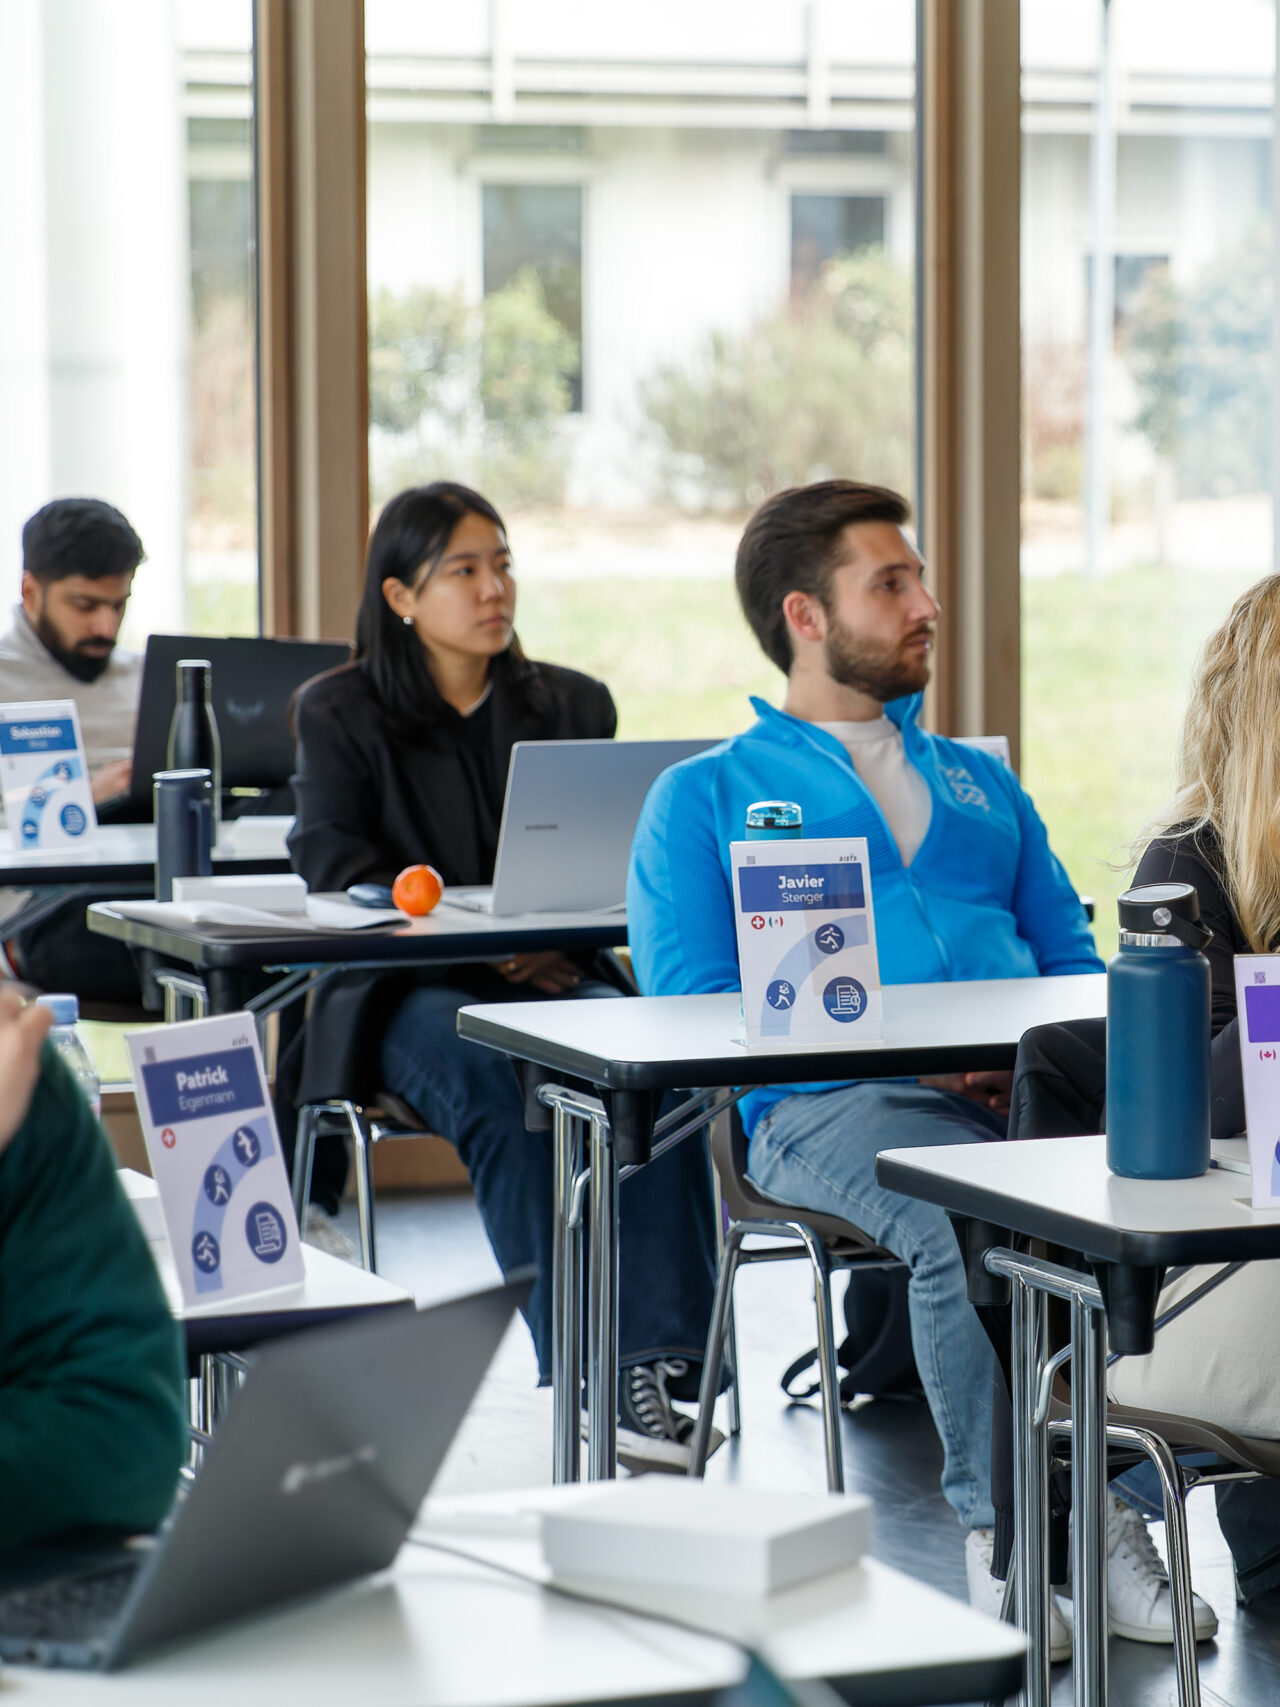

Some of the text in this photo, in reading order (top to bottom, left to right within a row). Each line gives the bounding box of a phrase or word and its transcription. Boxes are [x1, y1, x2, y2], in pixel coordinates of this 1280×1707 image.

[778, 874, 825, 889] Javier
[782, 892, 825, 904] Stenger
[176, 1065, 229, 1091] Patrick
[178, 1090, 236, 1112] Eigenmann
